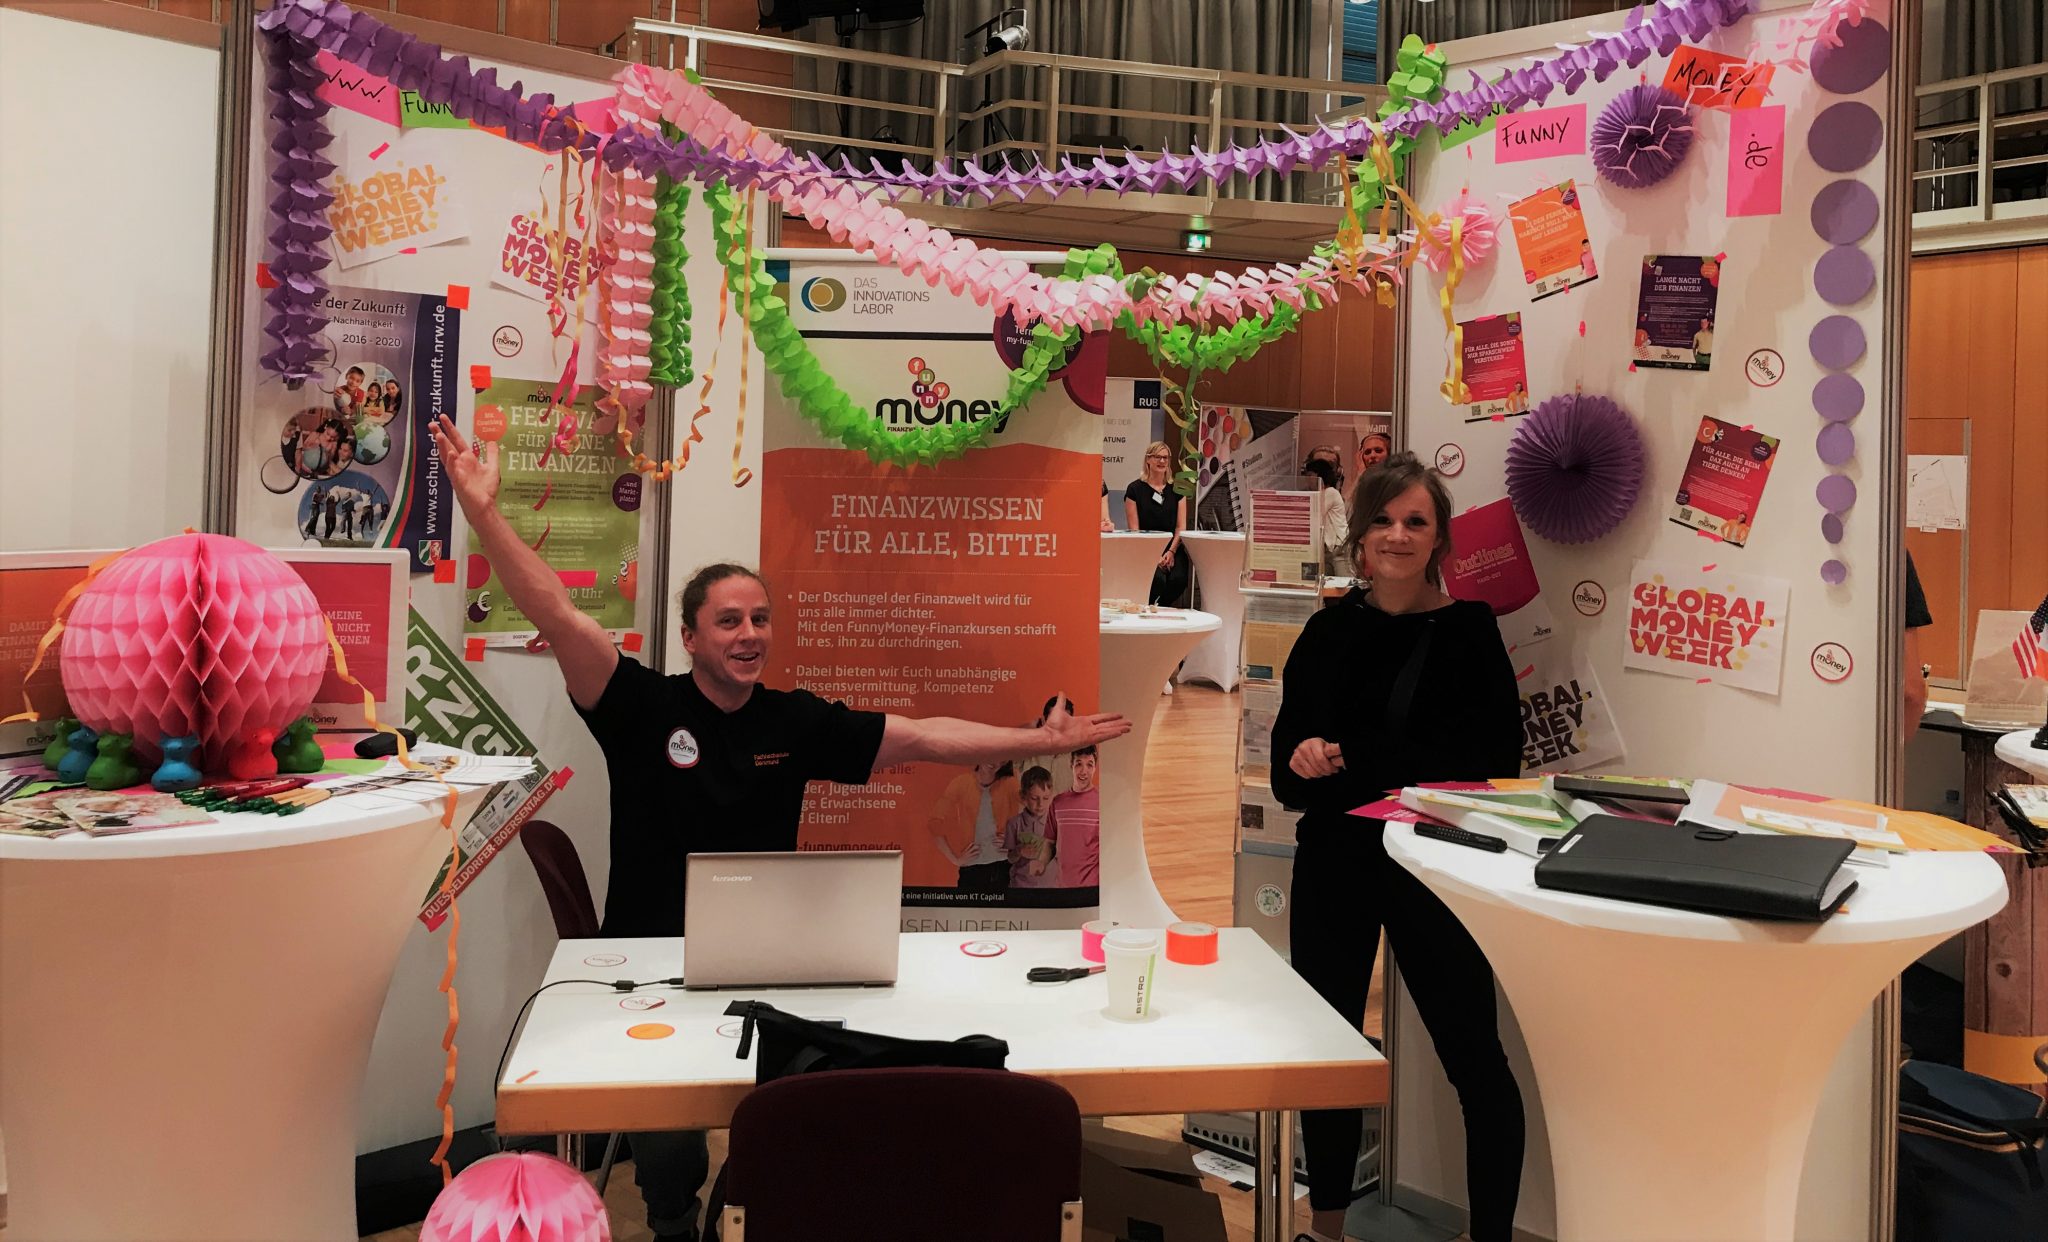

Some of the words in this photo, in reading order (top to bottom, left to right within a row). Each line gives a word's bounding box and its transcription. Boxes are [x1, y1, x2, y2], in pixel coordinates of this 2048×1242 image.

[1673, 57, 1755, 104] MONEY
[1502, 117, 1570, 148] FUNNY
[330, 186, 438, 233] MONEY
[335, 211, 429, 253] WEEK
[853, 277, 878, 289] DAS
[853, 290, 930, 302] INNOVATIONS
[326, 297, 346, 309] der
[351, 299, 405, 315] Zukunft
[853, 303, 894, 315] LABOR
[333, 316, 393, 329] Nachhaltigkeit
[342, 334, 367, 345] 2016
[376, 337, 401, 347] 2020
[496, 337, 519, 348] money
[1752, 357, 1777, 380] money
[1139, 397, 1159, 407] RUB
[517, 431, 547, 448] FÜR
[508, 451, 617, 475] FINANZEN
[1439, 452, 1460, 469] money
[1702, 445, 1714, 455] FÜR
[1733, 455, 1743, 464] DIE
[1744, 459, 1761, 470] BEIM
[1723, 459, 1740, 470] AUCH
[1741, 465, 1750, 474] AN
[831, 494, 1044, 521] FINANZWISSEN
[814, 525, 872, 554] FÜR
[879, 531, 958, 560] ALLE,
[967, 532, 1057, 558] BITTE!
[582, 588, 604, 599] Uhr
[799, 591, 820, 603] Der
[823, 592, 887, 606] Dschungel
[890, 592, 911, 604] der
[914, 592, 981, 605] Finanzwelt
[984, 593, 1011, 605] wird
[1014, 593, 1032, 606] für
[1576, 594, 1602, 605] money
[1634, 582, 1775, 627] GLOBAL
[798, 607, 820, 618] uns
[823, 606, 846, 618] alle
[849, 606, 888, 618] immer
[890, 607, 936, 619] dichter.
[337, 624, 371, 632] NICHT
[797, 621, 817, 632] Mit
[820, 621, 843, 632] den
[847, 621, 1011, 636] FunnyMoney-Finanzkursen
[1014, 623, 1057, 635] schafft
[1630, 606, 1761, 648] MONEY
[797, 635, 814, 647] Ihr
[817, 638, 834, 649] es,
[838, 635, 857, 647] ihn
[860, 638, 875, 647] zu
[878, 636, 962, 651] durchdringen.
[1629, 628, 1735, 670] WEEK
[1816, 653, 1847, 673] money
[796, 665, 832, 677] Dabei
[835, 665, 876, 677] bieten
[879, 666, 899, 677] wir
[902, 665, 932, 678] Euch
[935, 666, 1017, 681] unabhängige
[795, 679, 920, 695] Wissensvermittung,
[924, 681, 994, 695] Kompetenz
[858, 694, 869, 707] in
[873, 696, 915, 708] einem.
[671, 741, 697, 755] money
[829, 782, 906, 796] Jugendliche,
[820, 797, 897, 809] Erwachsene
[808, 812, 850, 824] Eltern!
[712, 874, 753, 882] lenovo
[923, 892, 954, 900] Initiative
[980, 893, 1005, 901] Capital
[1136, 975, 1146, 1014] BISTRO
